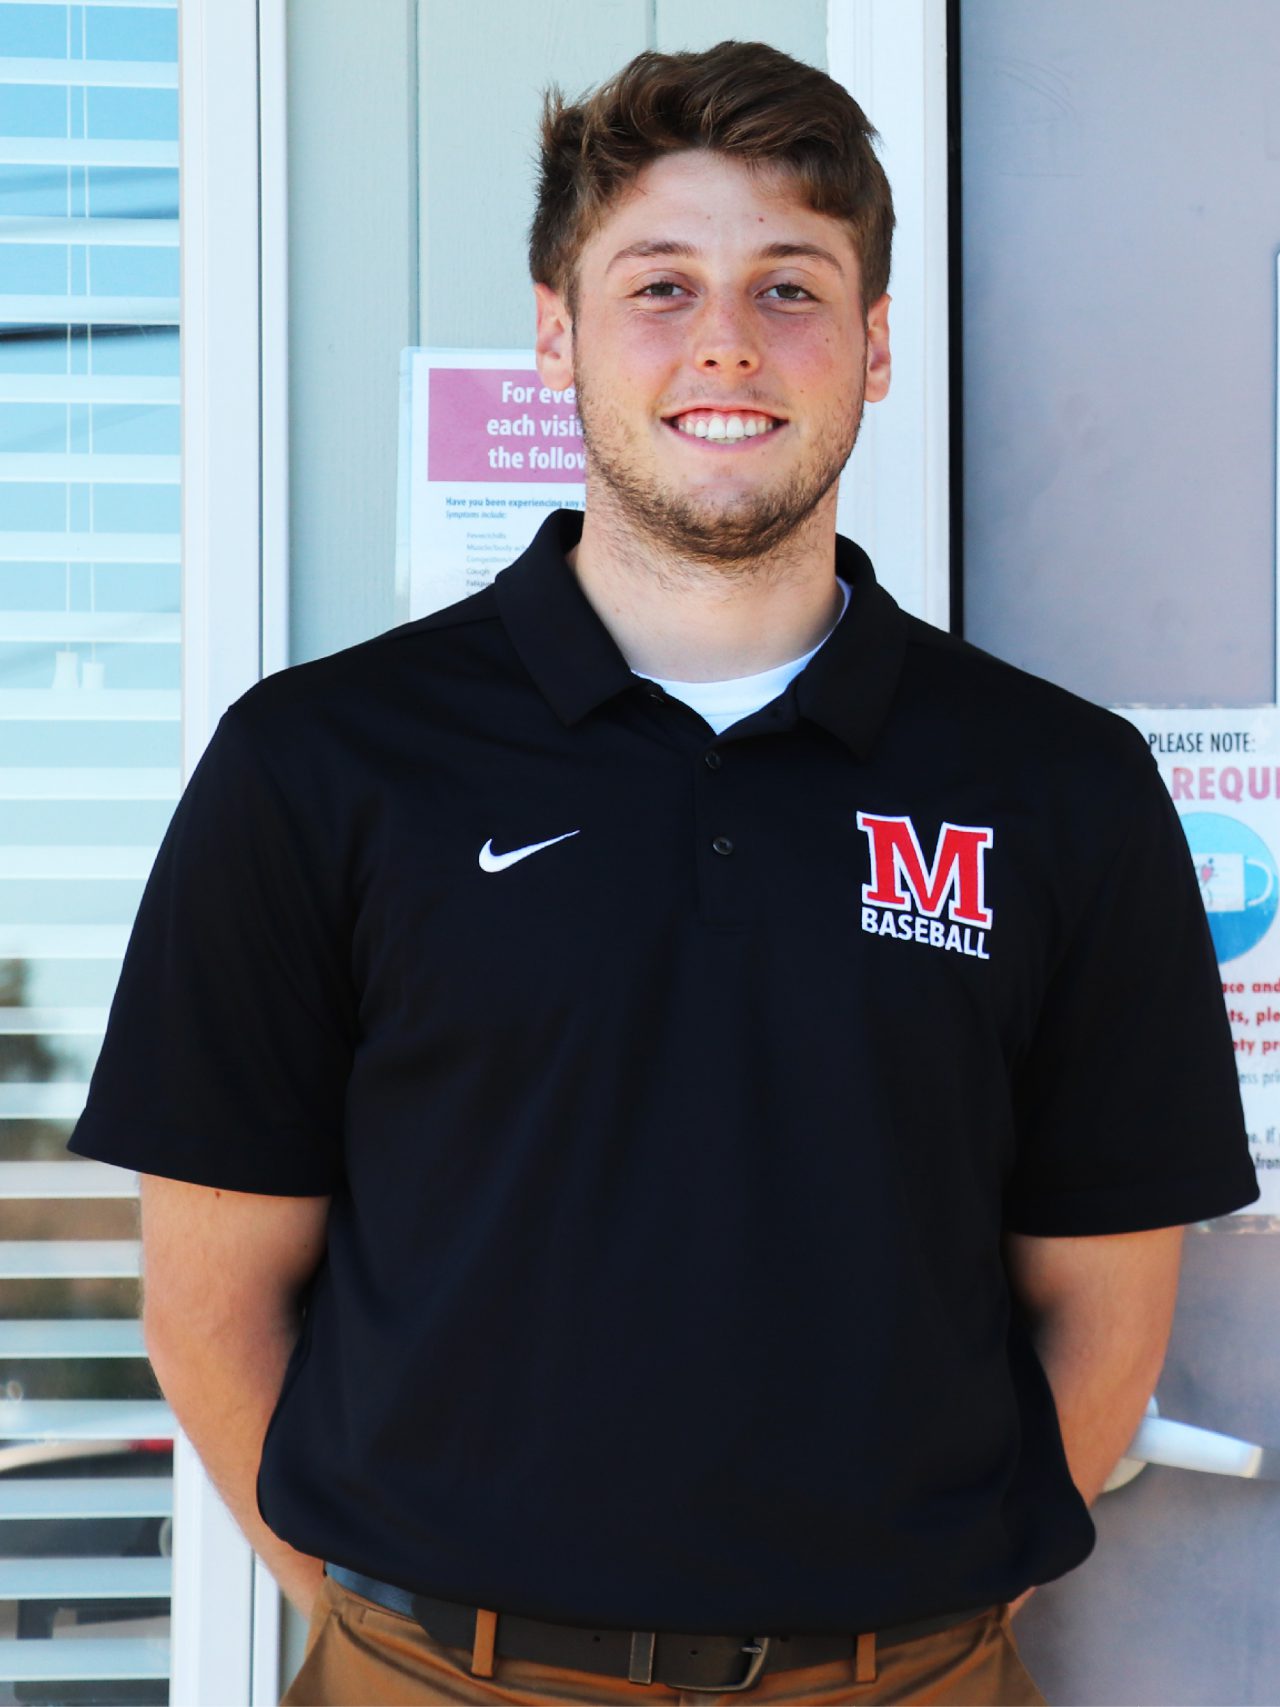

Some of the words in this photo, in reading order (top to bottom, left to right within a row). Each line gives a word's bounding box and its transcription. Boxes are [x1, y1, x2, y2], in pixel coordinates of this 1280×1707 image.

[502, 381, 535, 403] For
[539, 387, 576, 404] eve
[487, 414, 535, 437] each
[488, 446, 523, 469] the
[445, 497, 466, 506] Have
[468, 499, 483, 508] you
[485, 497, 506, 506] been
[508, 498, 562, 508] experiencing
[565, 500, 579, 508] any
[1149, 732, 1203, 753] PLEASE
[1211, 732, 1256, 753] NOTE:
[856, 810, 994, 930] M
[861, 906, 990, 960] BASEBALL
